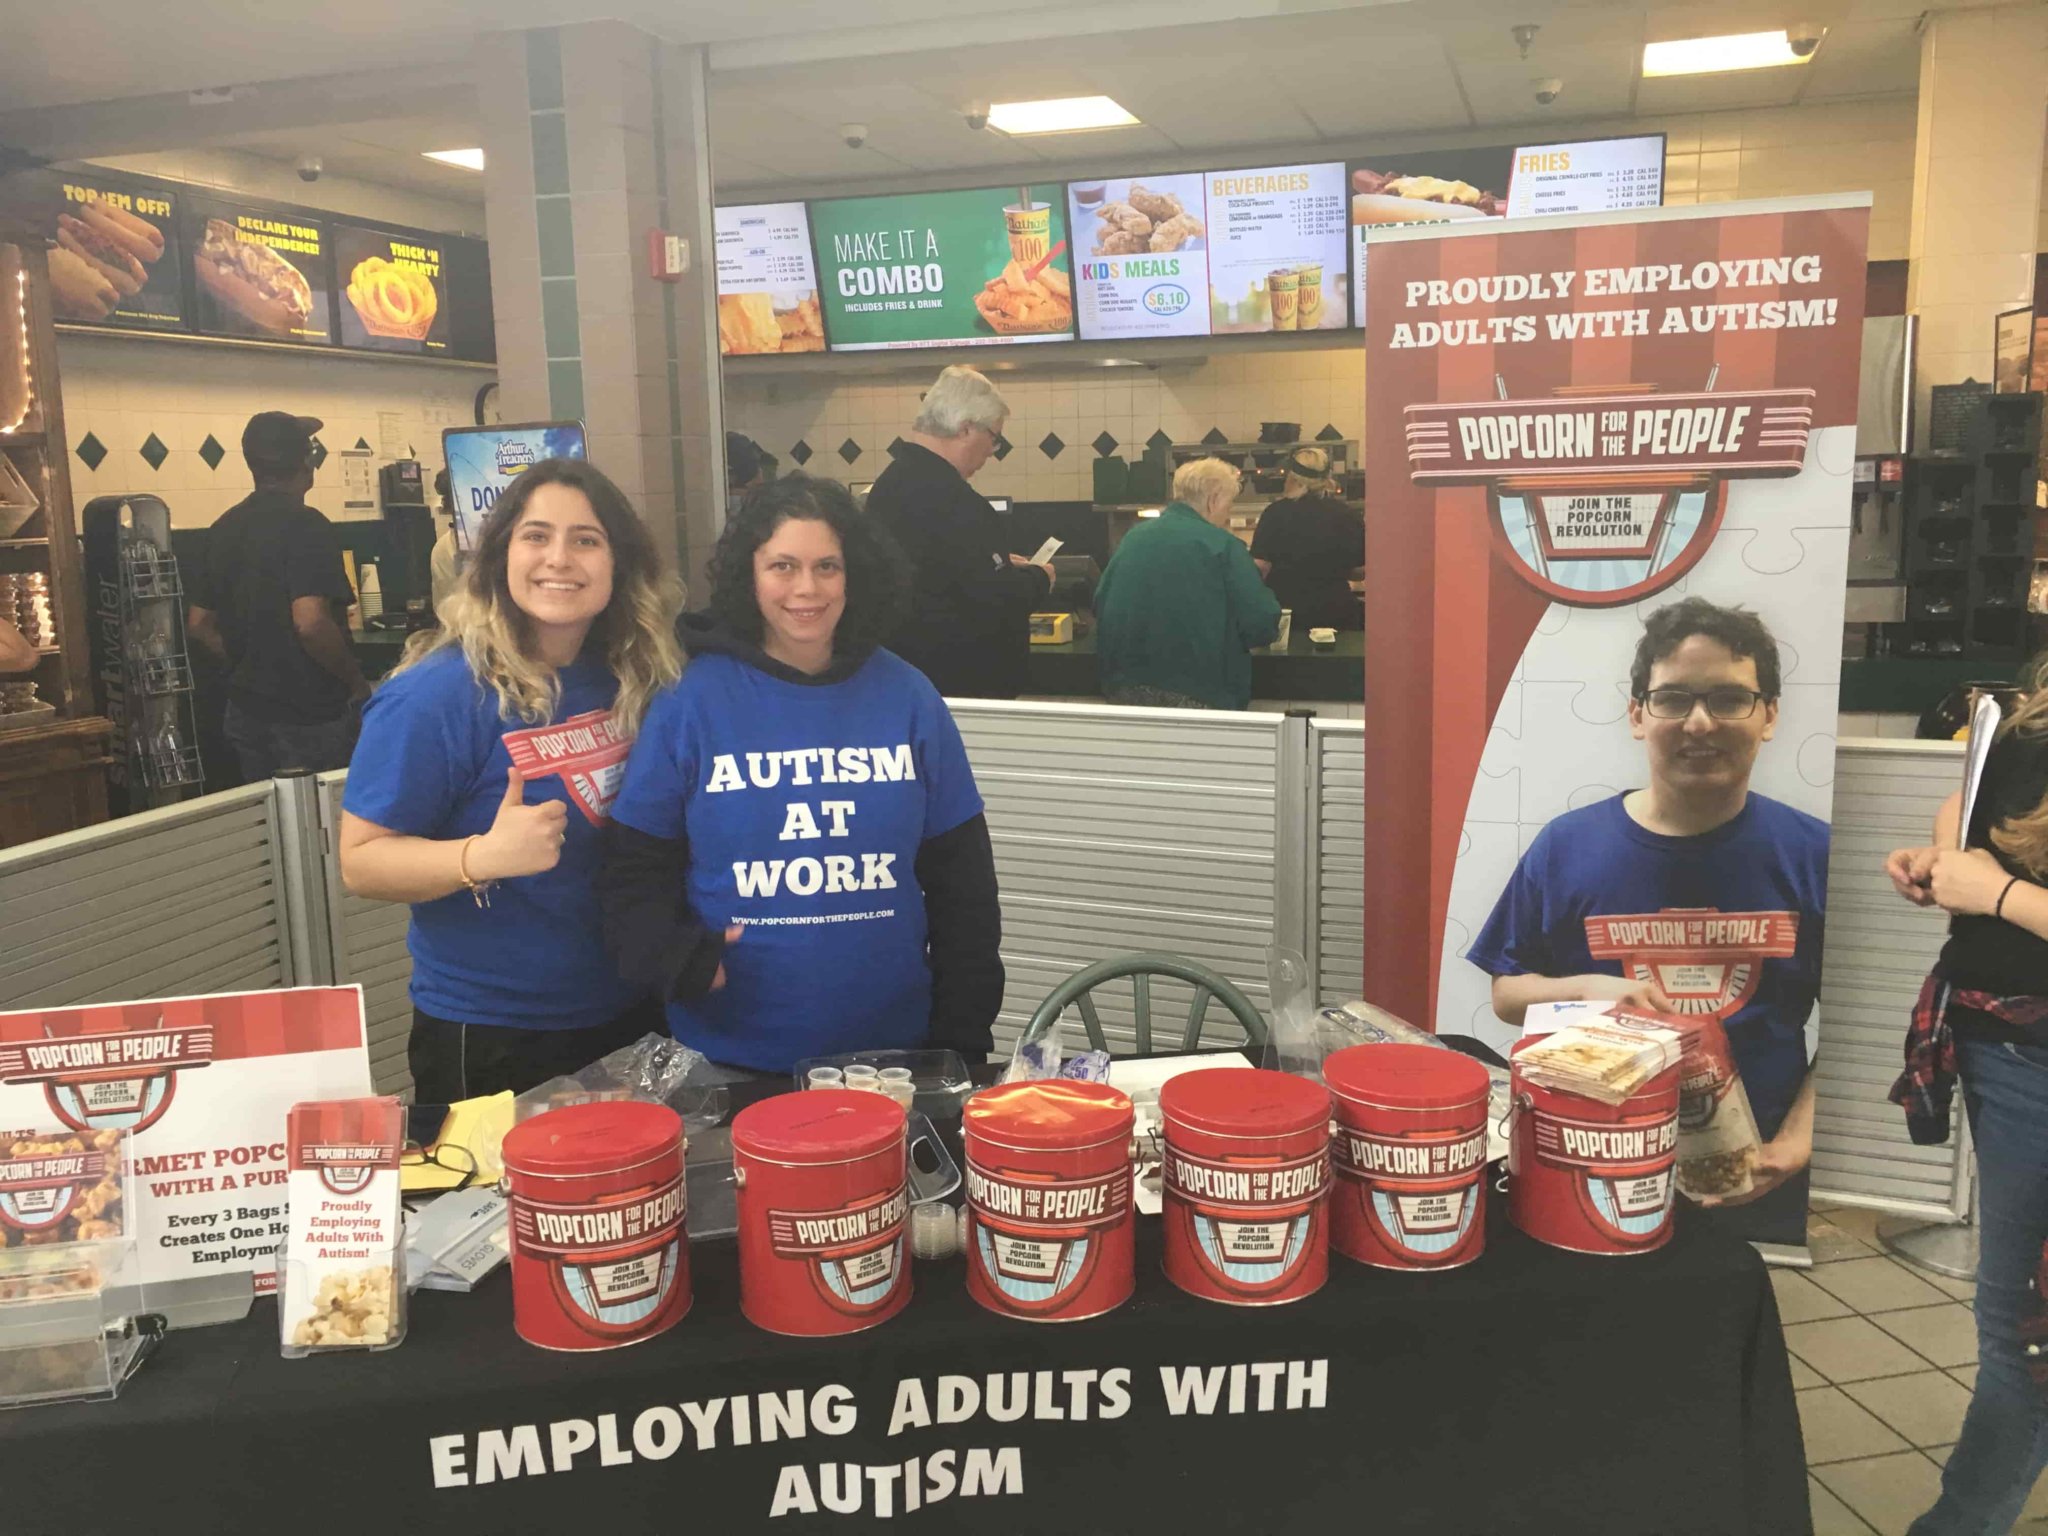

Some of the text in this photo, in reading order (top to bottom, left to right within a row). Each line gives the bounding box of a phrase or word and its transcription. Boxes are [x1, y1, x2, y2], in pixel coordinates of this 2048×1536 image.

[1519, 151, 1570, 173] FRIES
[1213, 173, 1309, 197] BEVERAGES
[63, 184, 98, 203] TOP
[136, 197, 171, 217] OFF!
[238, 216, 319, 241] DECLARE YOUR
[235, 231, 320, 256] INDEPENDENCE!
[390, 242, 426, 260] THICK
[834, 231, 892, 264] MAKE
[899, 229, 916, 259] IT
[925, 228, 940, 258] A
[394, 258, 440, 277] HEARTY
[1082, 258, 1180, 280] KIDS MEALS
[837, 263, 944, 297] COMBO
[1405, 255, 1822, 307] PROUDLY EMPLOYING
[844, 299, 943, 312] INCLUDES FRIES & DRINK
[1148, 292, 1184, 307] $6.10
[1389, 298, 1838, 349] ADULTS WITH AUTISM!
[1457, 406, 1751, 461] POPCORN FOR THE PEOPLE
[498, 440, 526, 454] Arthur
[1568, 497, 1632, 510] JOIN THE
[1567, 511, 1632, 524] POPCORN
[1556, 523, 1642, 537] REVOLUTION
[530, 727, 598, 761] POPCORN
[705, 744, 916, 792] AUTISM
[779, 800, 856, 841] AT
[732, 853, 897, 898] WORK
[731, 909, 895, 926] WWW.POPCORNFORTHEPEOPLE.COM
[1607, 921, 1686, 946] POPCORN
[1705, 919, 1771, 945] PEOPLE
[26, 1034, 182, 1071] POPCORN FOR THE PEOPLE
[94, 1083, 111, 1091] JOIN
[94, 1088, 129, 1097] POPCORN
[88, 1095, 135, 1106] REVOLUTION
[1562, 1127, 1645, 1159] POPCORN
[213, 1143, 289, 1168] POPC
[315, 1148, 347, 1160] POPCORN
[353, 1148, 381, 1160] PEOPLE
[1350, 1138, 1430, 1174] POPCORN
[1432, 1146, 1448, 1160] FOR
[44, 1158, 84, 1177] PEOPLE
[1433, 1161, 1446, 1173] THE
[150, 1177, 214, 1198] WITH
[220, 1175, 238, 1190] A
[1175, 1158, 1323, 1201] POPCORN FOR THE PEOPLE
[966, 1165, 1108, 1219] POPCORN FOR THE PEOPLE
[321, 1200, 373, 1213] Proudly
[535, 1182, 686, 1244] POPCORN FOR THE PEOPLE
[868, 1208, 880, 1221] FOR
[1417, 1205, 1448, 1213] POPCORN
[167, 1213, 218, 1228] Every
[223, 1209, 232, 1221] 3
[236, 1206, 280, 1220] Bags
[310, 1216, 381, 1229] Employing
[1412, 1213, 1451, 1222] REVOLUTION
[796, 1212, 868, 1244] POPCORN
[869, 1221, 880, 1233] THE
[160, 1231, 226, 1248] Creates
[229, 1227, 264, 1240] One
[305, 1232, 384, 1242] Adults With
[1232, 1242, 1275, 1250] REVOLUTION
[317, 1247, 370, 1258] Autism!
[1009, 1249, 1041, 1260] POPCORN
[1010, 1241, 1041, 1252] JOIN THE
[460, 1243, 495, 1271] GLOVES
[859, 1256, 873, 1265] JOIN
[859, 1258, 883, 1271] POPCORN
[1005, 1256, 1046, 1269] REVOLUTION
[612, 1261, 644, 1275] JOIN THE
[612, 1269, 645, 1283] POPCORN
[856, 1264, 887, 1279] REVOLUTION
[255, 1278, 277, 1287] FOR
[607, 1276, 650, 1292] REVOLUTION
[429, 1359, 1330, 1490] EMPLOYING ADULTS WITH
[769, 1447, 1024, 1518] AUTISM
